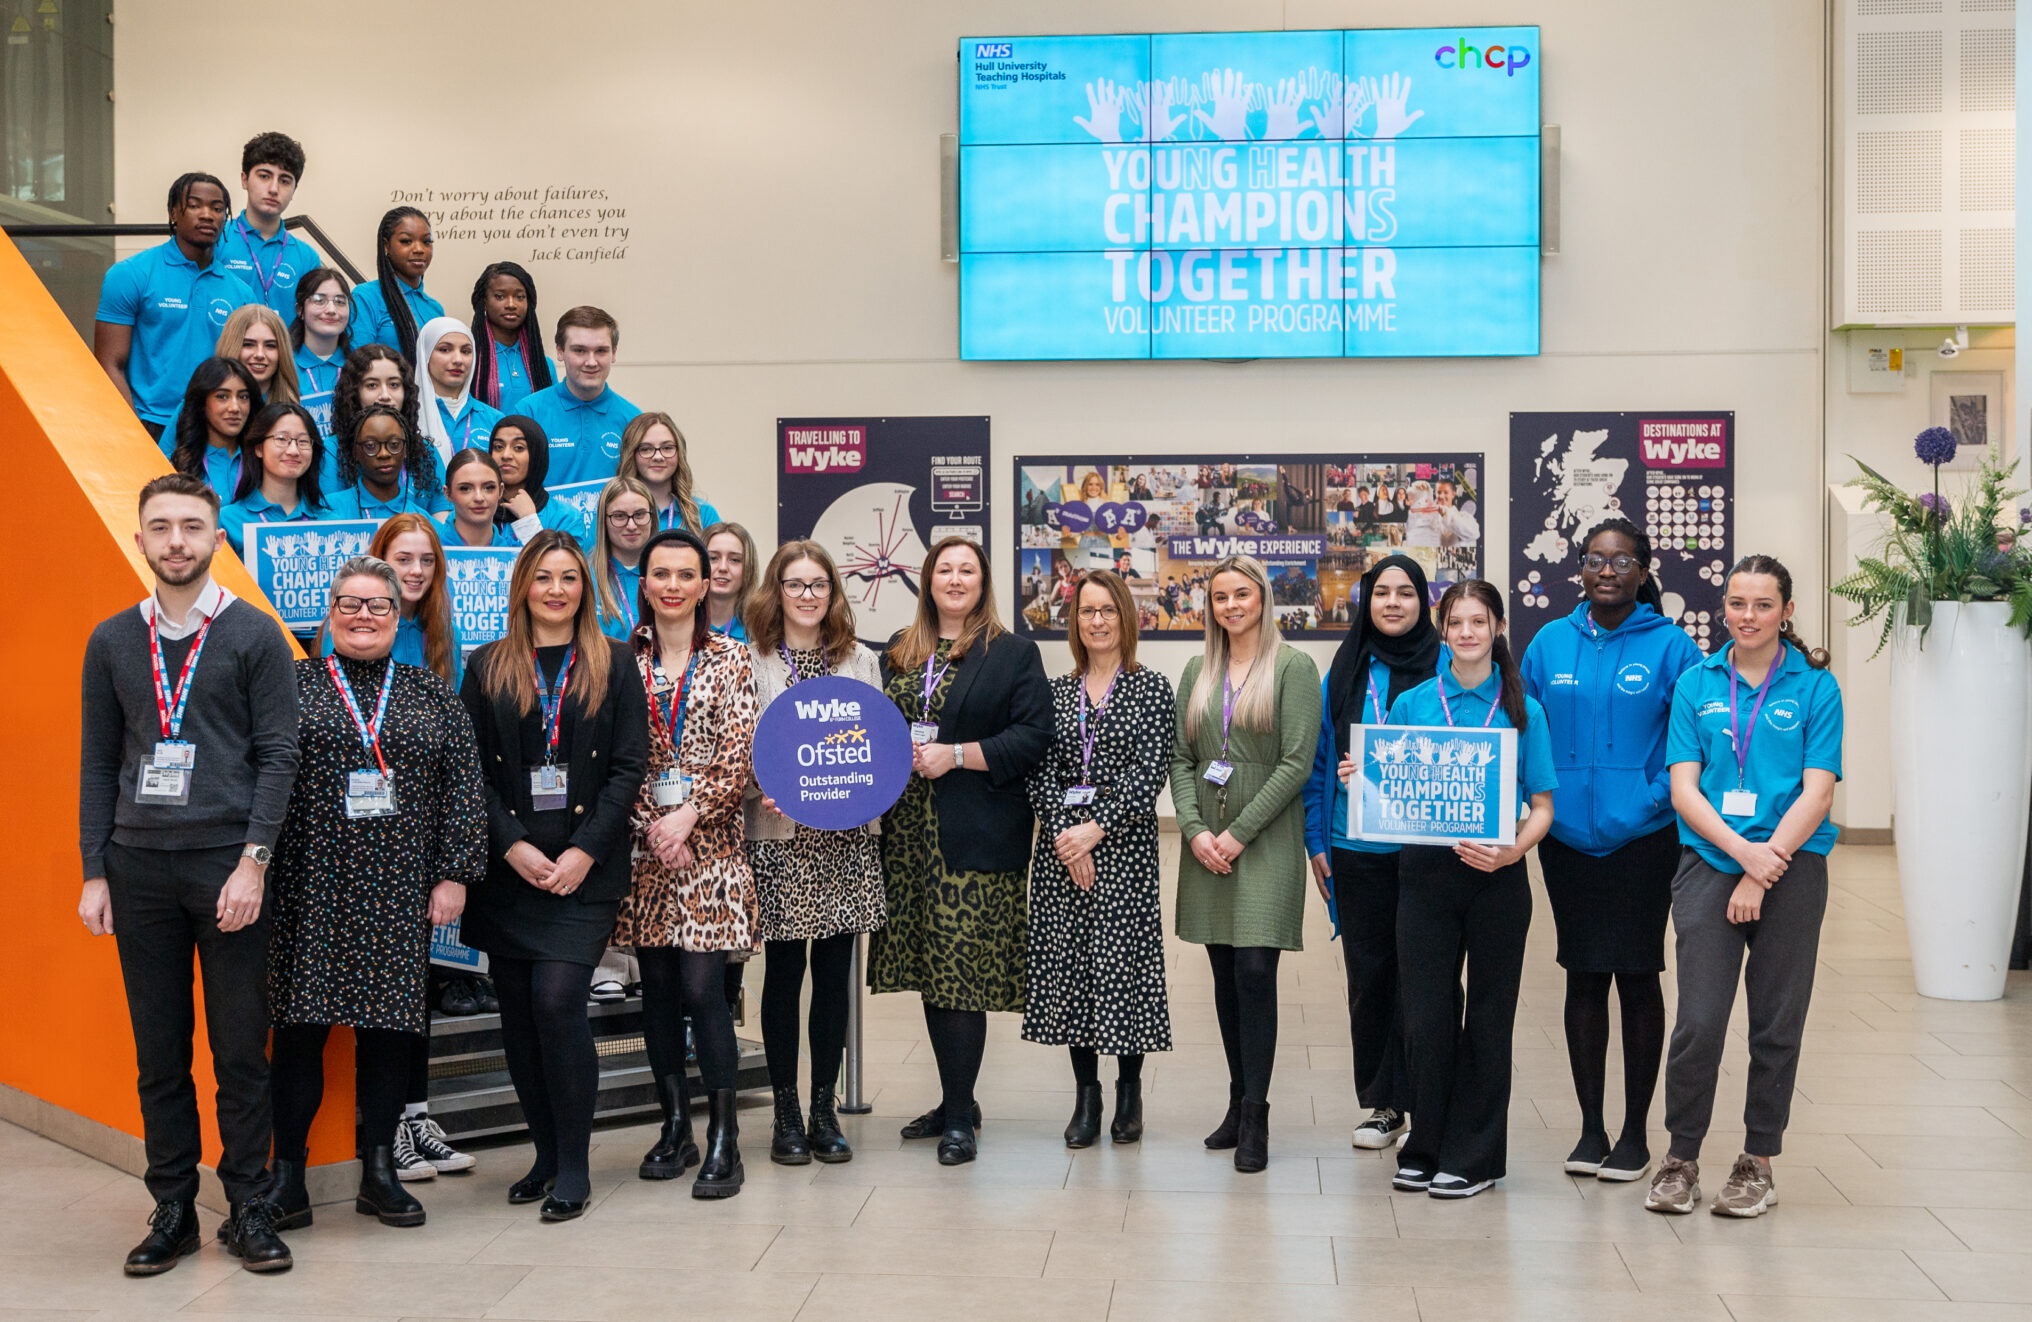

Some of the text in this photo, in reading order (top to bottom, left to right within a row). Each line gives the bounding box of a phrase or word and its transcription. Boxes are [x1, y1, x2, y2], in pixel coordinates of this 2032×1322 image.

[976, 44, 1011, 58] NHS
[1435, 38, 1530, 77] chcp
[975, 61, 1047, 72] Hull University
[976, 72, 1066, 83] Teaching Hospitals
[1102, 145, 1396, 190] YOUNG HEALTH
[391, 185, 609, 206] Don't worry about failures,
[450, 206, 494, 221] about
[500, 206, 525, 220] the
[529, 204, 592, 220] chances
[597, 208, 627, 224] you
[1103, 187, 1398, 243] CHAMPIONS
[436, 224, 630, 245] when you don't even try
[528, 246, 630, 265] Jack Canfield
[277, 271, 291, 280] NHS
[1104, 246, 1397, 303] TOGETHER
[215, 307, 228, 317] NHS
[1104, 303, 1397, 334] VOLUNTEER PROGRAMME
[788, 430, 861, 445] TRAVELLING TO
[1643, 423, 1722, 437] DESTINATIONS AT
[606, 441, 619, 449] NHS
[1643, 438, 1721, 465] Wyke
[789, 446, 862, 472] Wyke
[931, 456, 983, 466] FIND YOUR ROUTE
[1172, 536, 1321, 559] THE Wyke EXPERIENCE
[271, 557, 317, 572] YOUNG
[452, 581, 496, 596] YOUNG
[273, 588, 331, 609] TOGET
[452, 595, 508, 612] CHAMP
[453, 612, 509, 631] TOGET
[795, 699, 861, 723] Wyke
[1697, 707, 1731, 717] VOLUNTEER
[1774, 709, 1793, 719] NHS
[797, 739, 872, 767] Ofsted
[799, 772, 874, 787] Outstanding
[1379, 764, 1486, 782] YOUNG HEALTH
[800, 787, 851, 802] Provider
[1379, 780, 1486, 801] CHAMPIONS
[1379, 799, 1485, 822] TOGETHER
[1378, 818, 1485, 834] VOLUNTEER PROGRAMME
[436, 944, 471, 961] PROGRAMME
